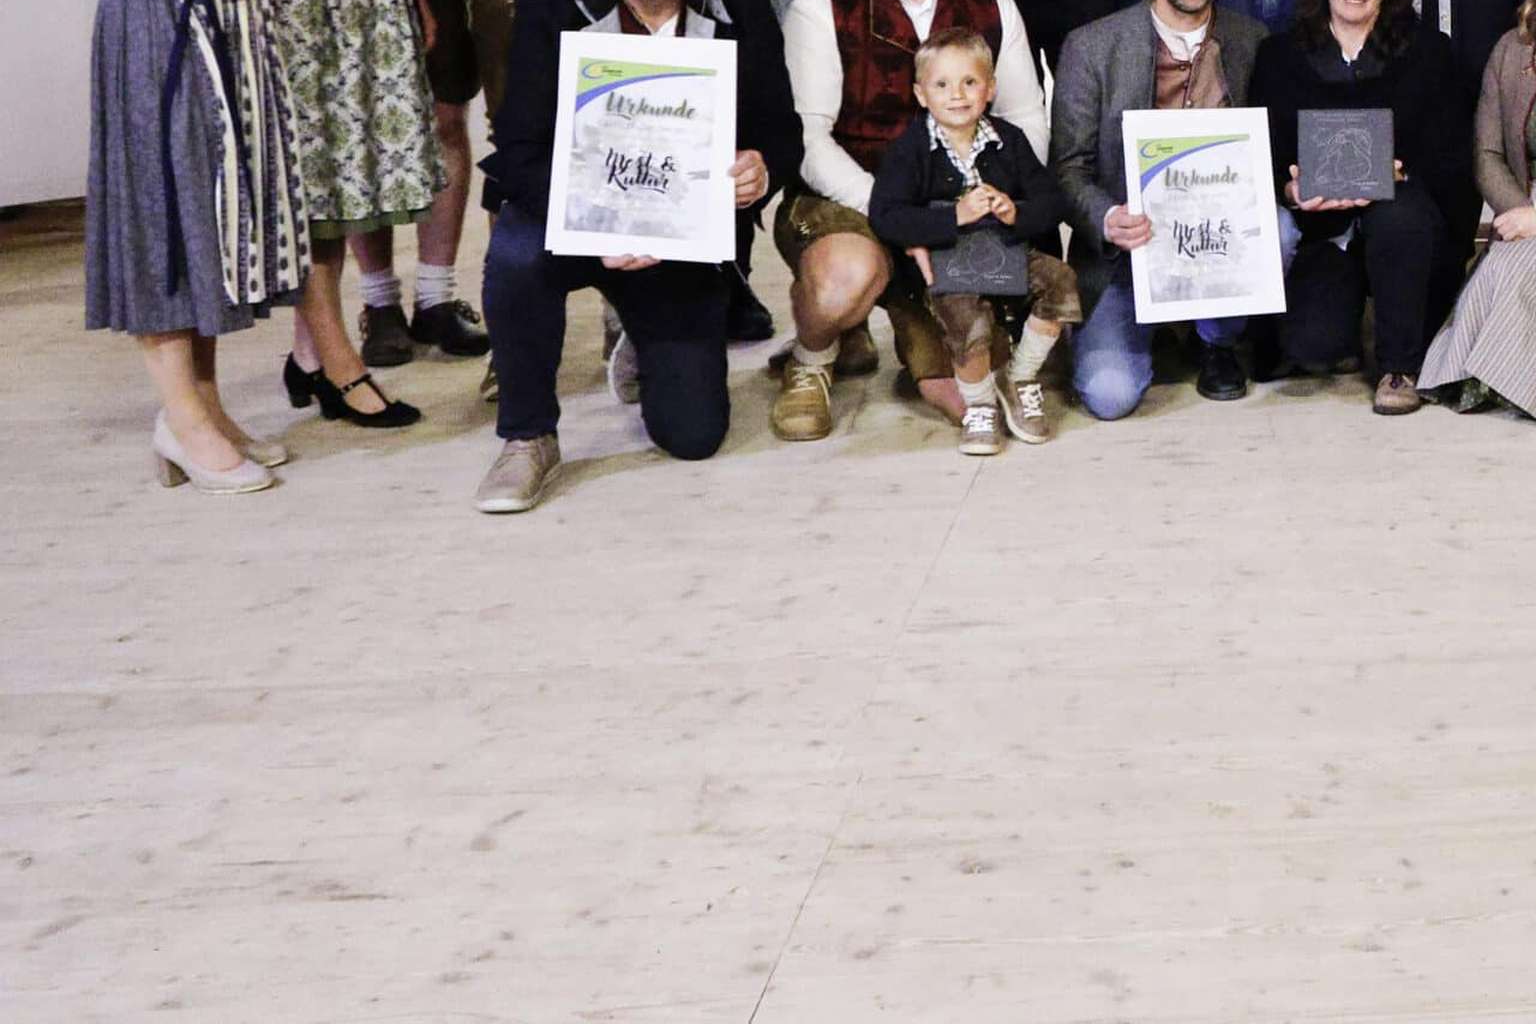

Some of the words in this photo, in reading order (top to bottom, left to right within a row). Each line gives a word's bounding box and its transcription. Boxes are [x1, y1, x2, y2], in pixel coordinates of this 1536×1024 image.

[605, 91, 697, 120] Urkunde
[660, 155, 677, 172] &
[1164, 165, 1239, 192] Urkunde
[1218, 218, 1232, 234] &
